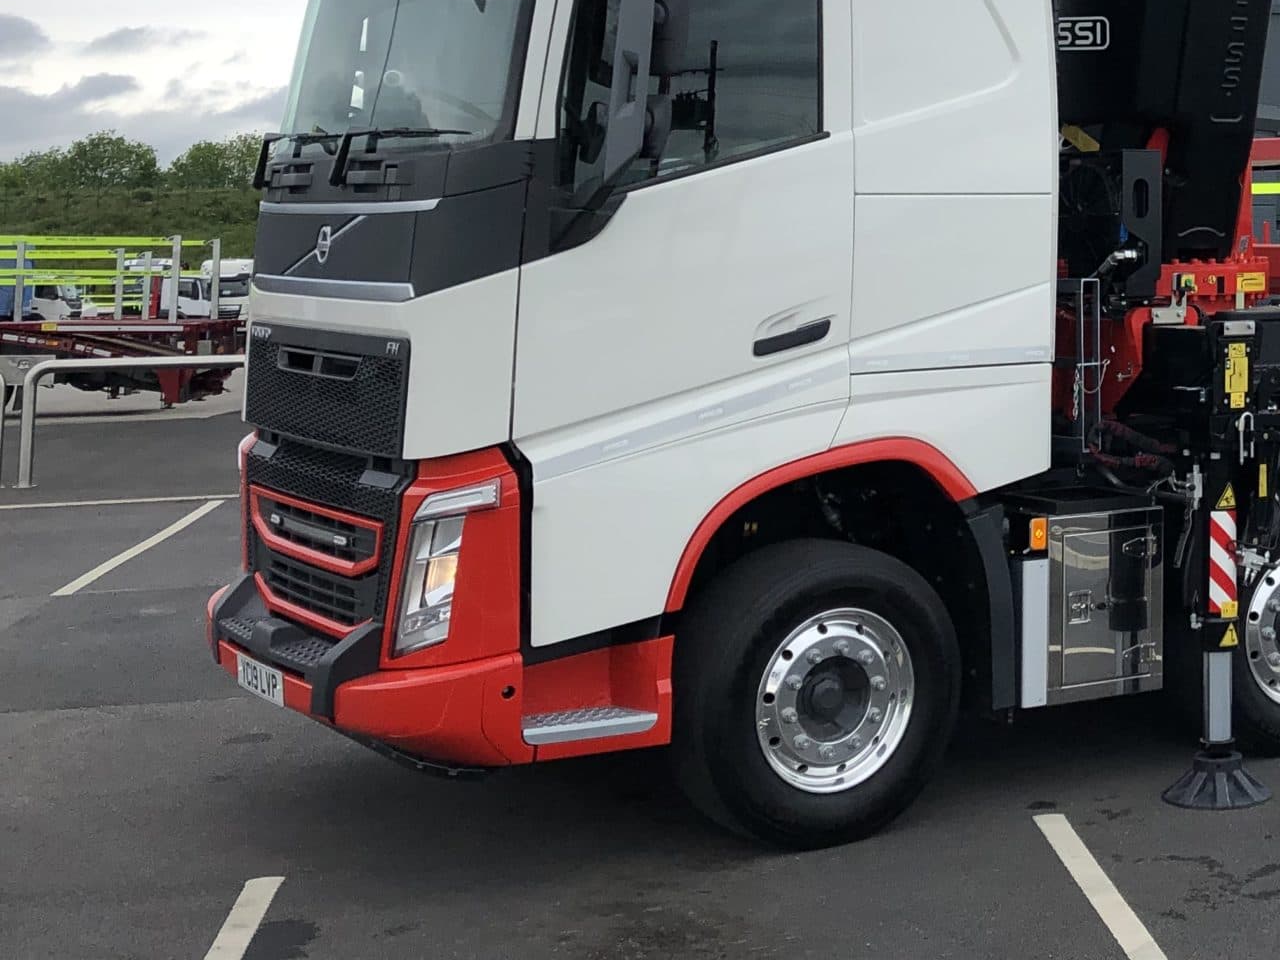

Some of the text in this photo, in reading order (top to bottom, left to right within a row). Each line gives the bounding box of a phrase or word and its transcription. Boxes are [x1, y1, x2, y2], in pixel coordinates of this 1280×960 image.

[1057, 21, 1102, 46] SSI
[385, 341, 401, 356] FH
[259, 668, 278, 699] LVP
